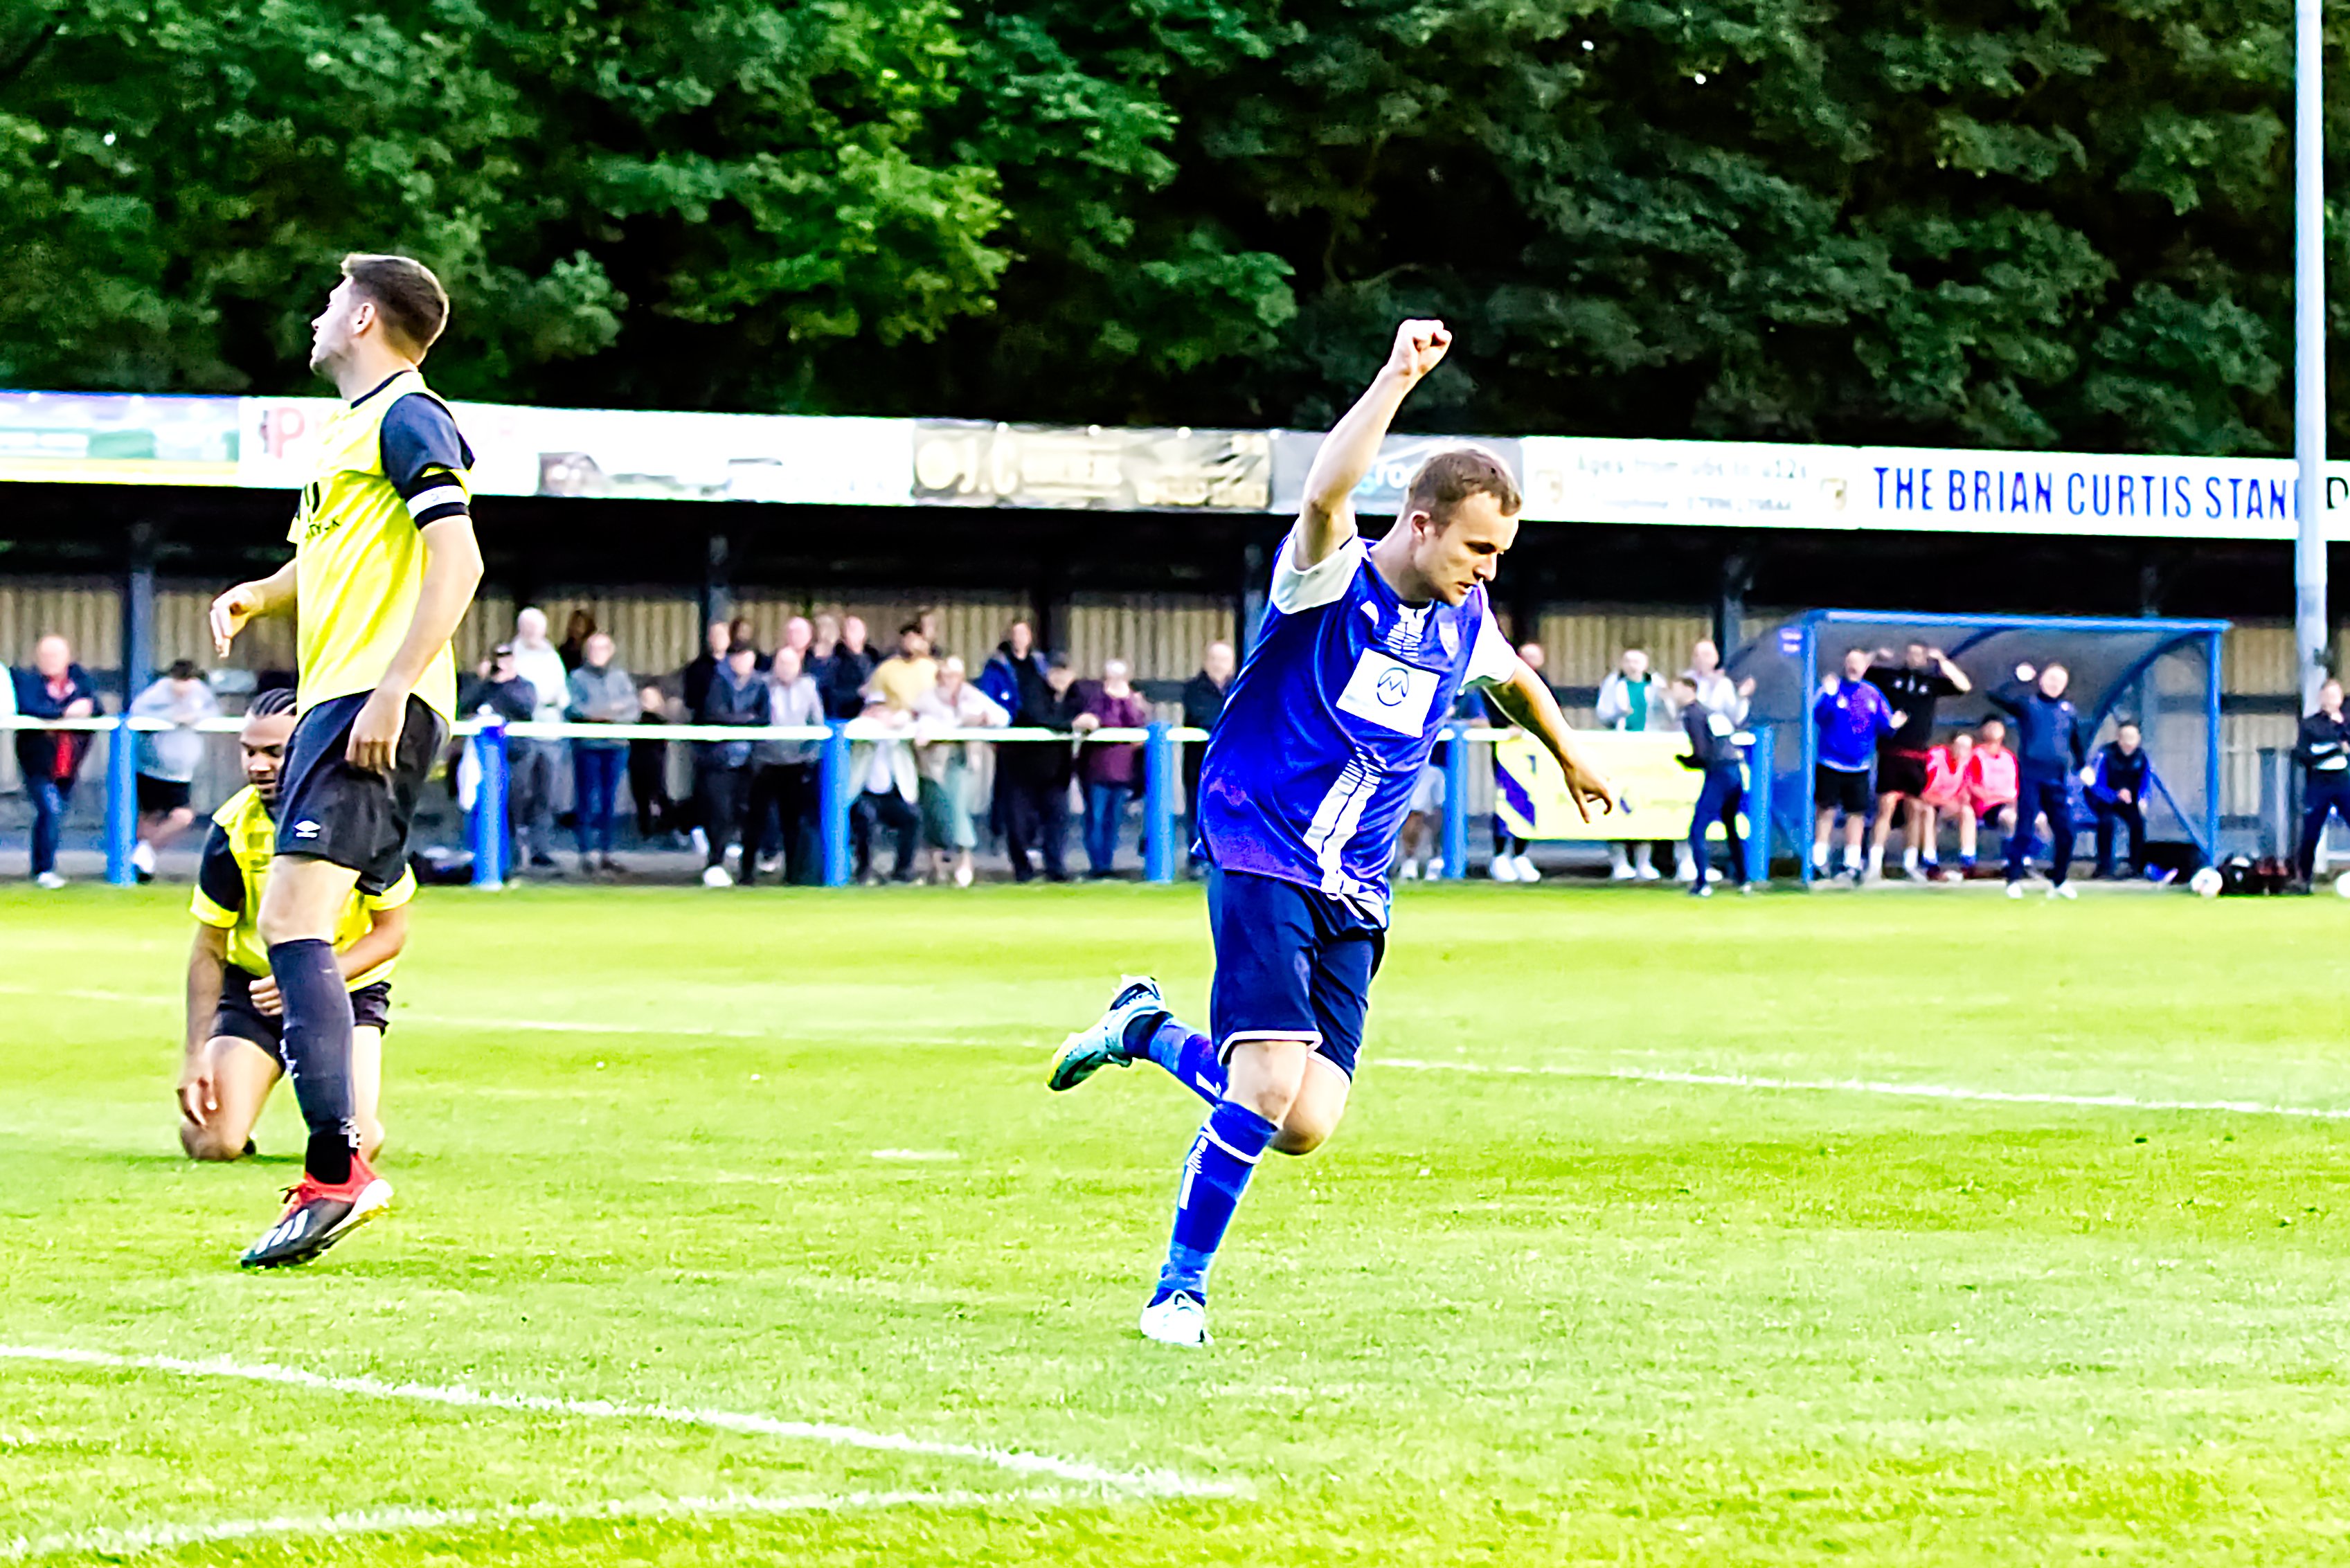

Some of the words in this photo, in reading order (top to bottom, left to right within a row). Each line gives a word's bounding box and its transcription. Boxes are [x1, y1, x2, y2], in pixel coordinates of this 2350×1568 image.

[1874, 467, 1933, 510] THE
[1948, 469, 2053, 514] BRIAN
[2068, 472, 2191, 518] CURTIS
[2205, 476, 2301, 521] STAN
